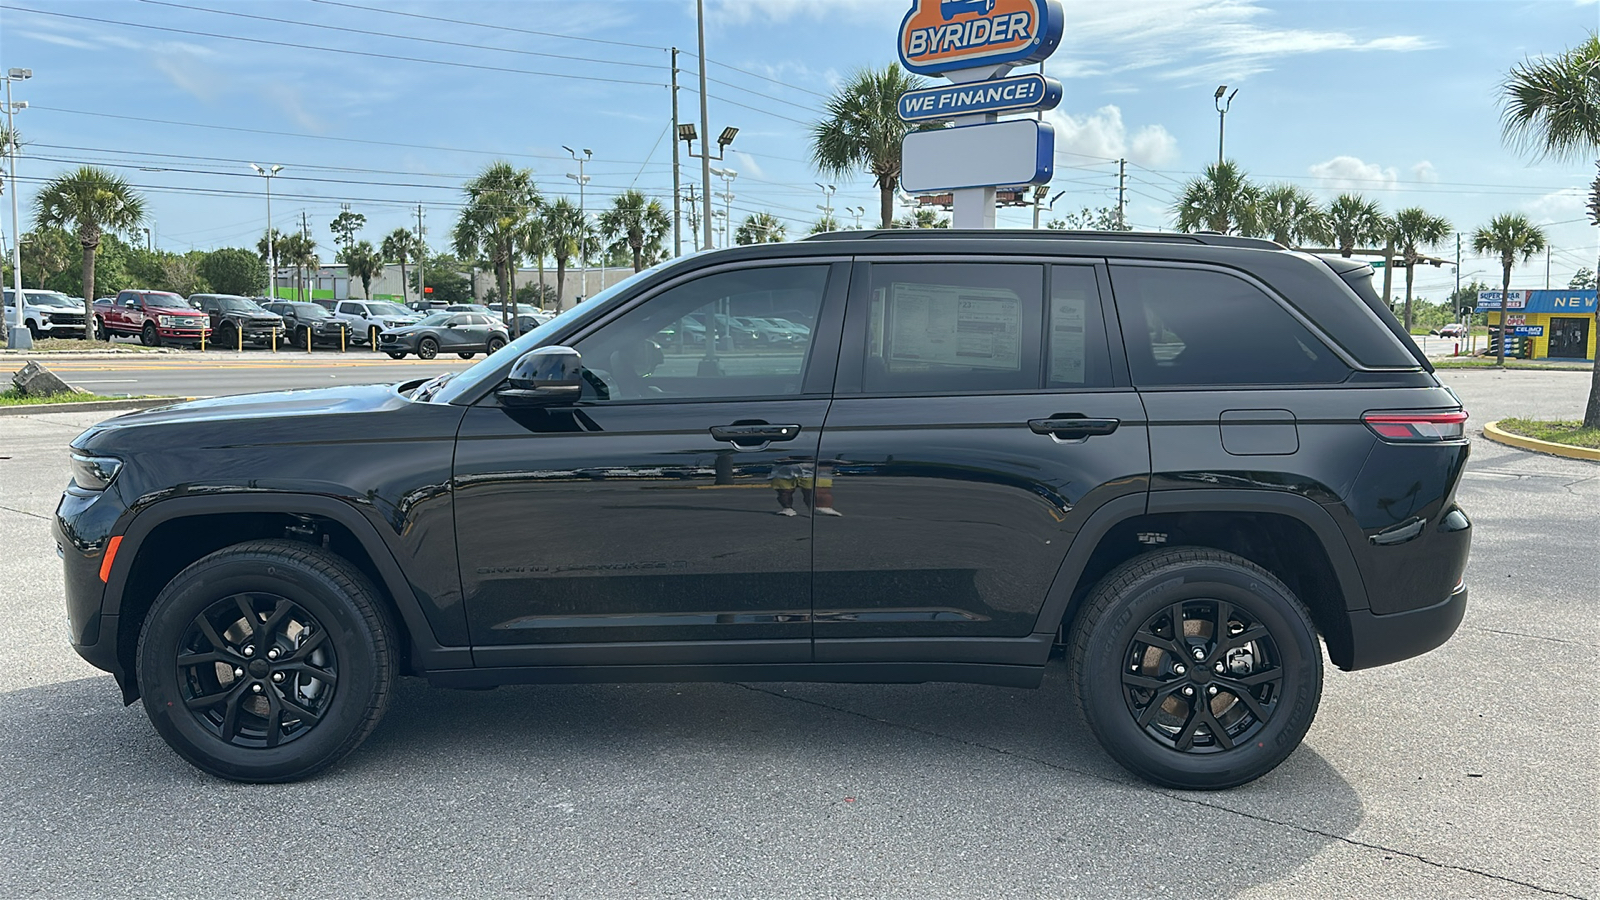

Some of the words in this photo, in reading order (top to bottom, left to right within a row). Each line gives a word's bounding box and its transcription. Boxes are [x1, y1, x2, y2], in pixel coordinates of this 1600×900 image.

[908, 12, 1030, 55] BYRIDER
[905, 95, 936, 113] WE
[938, 82, 1037, 109] FINANCE!
[1554, 297, 1595, 307] NEW
